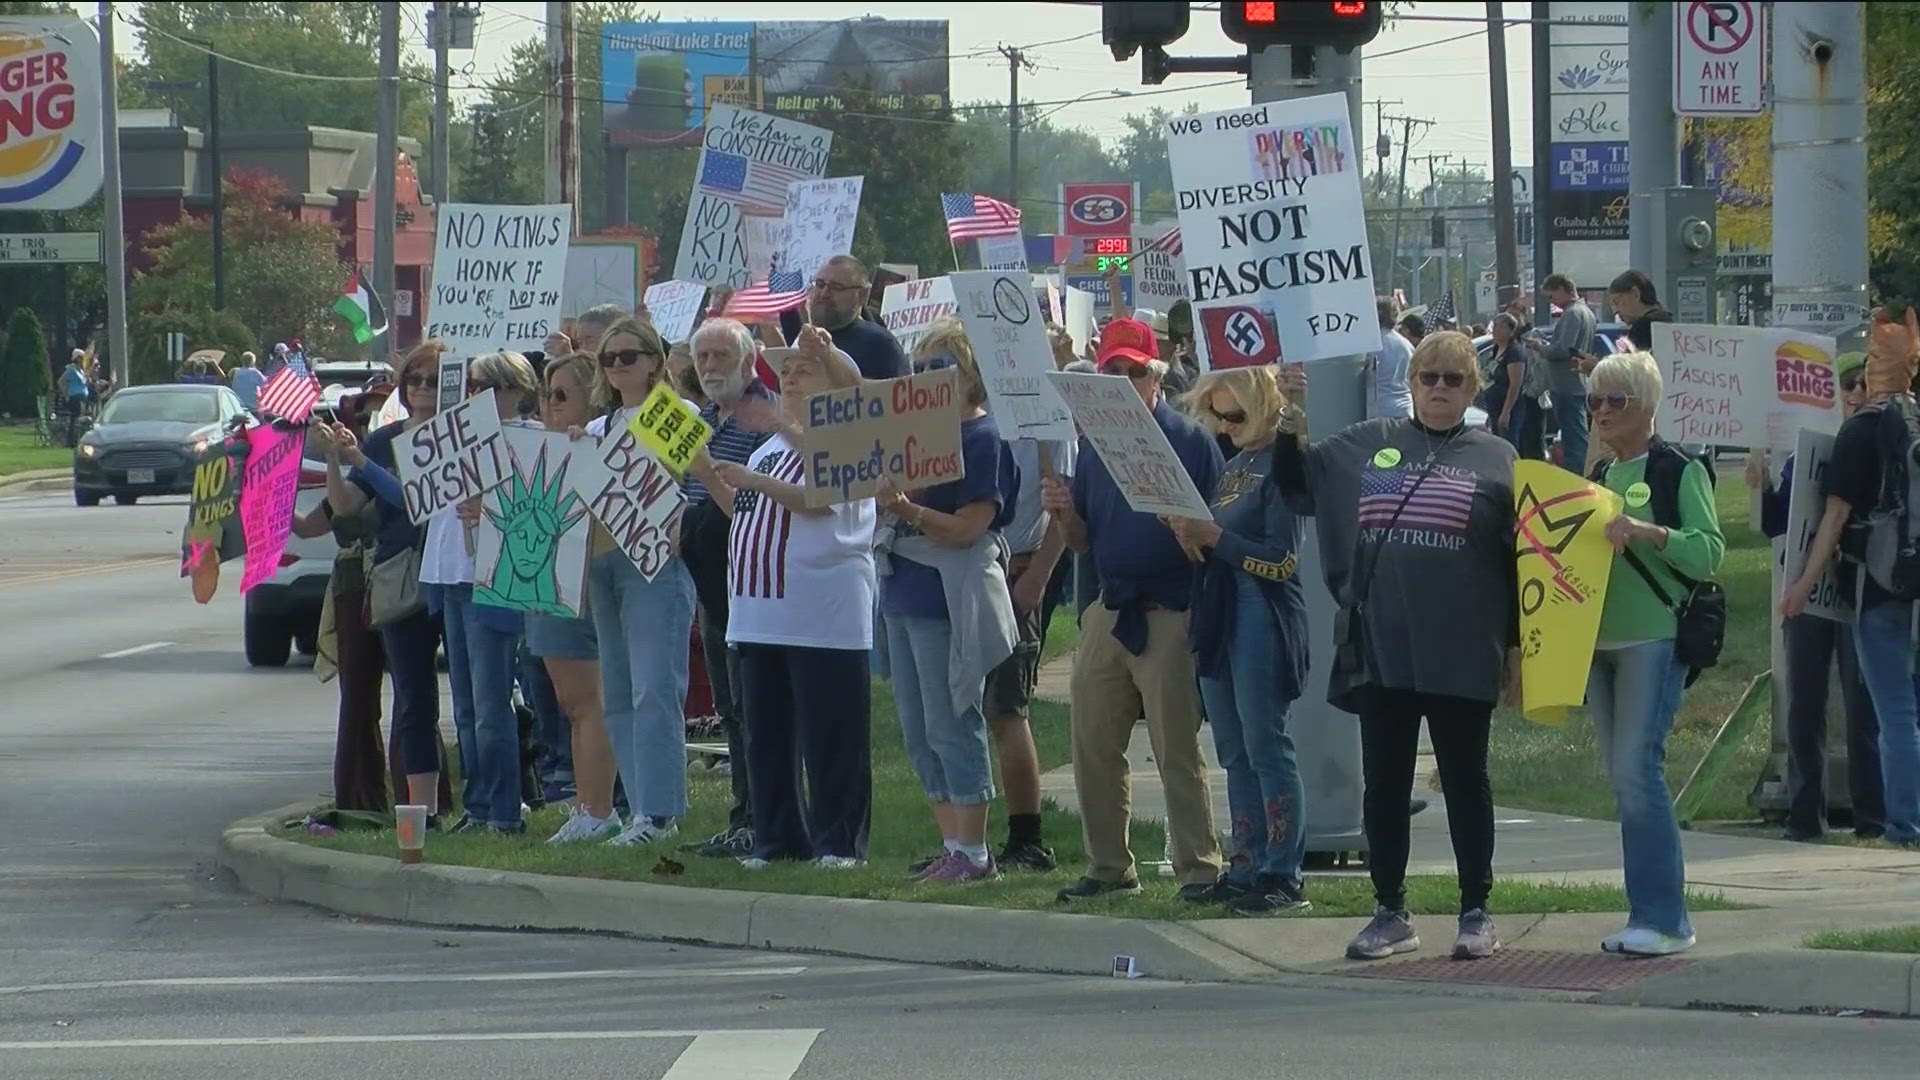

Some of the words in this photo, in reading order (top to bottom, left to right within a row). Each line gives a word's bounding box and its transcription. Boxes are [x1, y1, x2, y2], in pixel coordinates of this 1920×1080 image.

[714, 32, 748, 49] Erie!
[1702, 61, 1739, 79] ANY
[1699, 85, 1741, 104] TIME
[731, 110, 760, 132] We
[761, 119, 802, 148] have
[812, 136, 823, 150] a
[1169, 121, 1202, 136] we
[1216, 107, 1269, 131] need
[706, 126, 828, 176] CONSTITUTION
[1179, 176, 1308, 210] DIVERSITY
[446, 212, 484, 248] NO
[494, 215, 560, 248] KINGS
[1218, 205, 1308, 249] NOT
[22, 238, 45, 248] TRIO
[29, 248, 58, 258] MINIS
[457, 258, 517, 282] HONK
[525, 261, 542, 285] IF
[692, 261, 717, 281] NO
[1188, 245, 1367, 303] FASCISM
[437, 283, 494, 306] YOU'RE
[510, 288, 534, 309] NOT
[539, 290, 559, 306] IN
[907, 281, 933, 301] WE
[484, 306, 505, 320] the
[884, 302, 957, 331] DESERVE
[1306, 313, 1359, 336] FDT
[428, 321, 495, 339] EPSTEIN
[506, 319, 549, 341] FILES
[1672, 331, 1744, 358] RESIST
[1672, 361, 1742, 396] FASCISM
[1777, 359, 1833, 379] NO
[1777, 372, 1836, 399] KINGS
[810, 388, 864, 427] Elect
[868, 397, 884, 417] a
[1668, 391, 1730, 416] TRASH
[412, 403, 477, 468] SHE
[1674, 415, 1743, 441] TRUMP
[195, 456, 227, 501] NO
[404, 432, 502, 522] DOESN'T
[604, 430, 674, 512] BOW
[813, 439, 885, 499] Expect
[889, 454, 904, 475] a
[905, 435, 958, 481] Circus
[195, 498, 236, 524] KINGS
[591, 477, 671, 578] KINGS
[1361, 527, 1466, 550] ANTI-TRUMP
